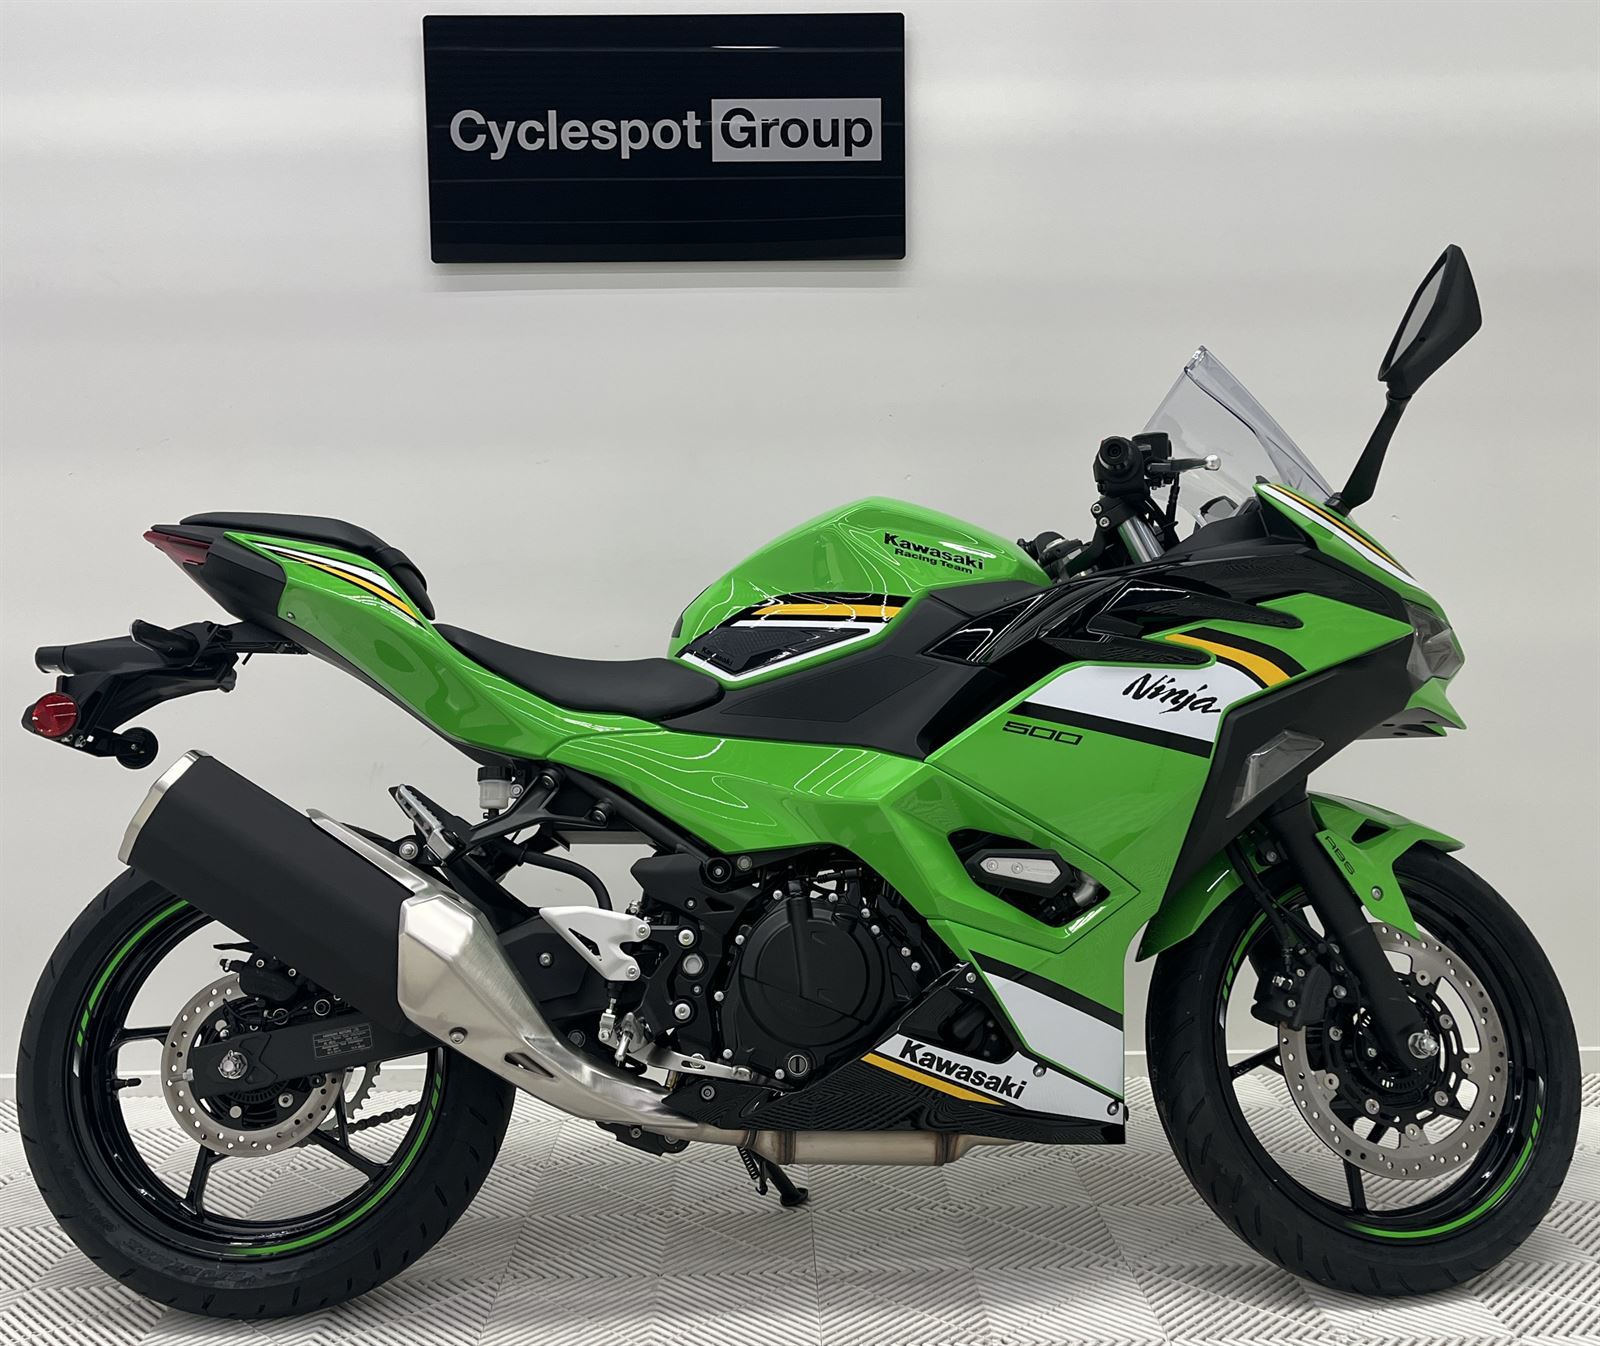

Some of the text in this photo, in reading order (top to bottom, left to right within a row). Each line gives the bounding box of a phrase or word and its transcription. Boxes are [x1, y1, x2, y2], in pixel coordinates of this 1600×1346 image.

[449, 107, 873, 160] Cyclespot Group
[884, 533, 984, 570] Kawasaki
[894, 548, 973, 575] Racing Team
[1122, 673, 1222, 714] Ninja
[1002, 720, 1083, 746] 500
[1325, 835, 1356, 876] ABS
[898, 1039, 1028, 1100] Kawasaki
